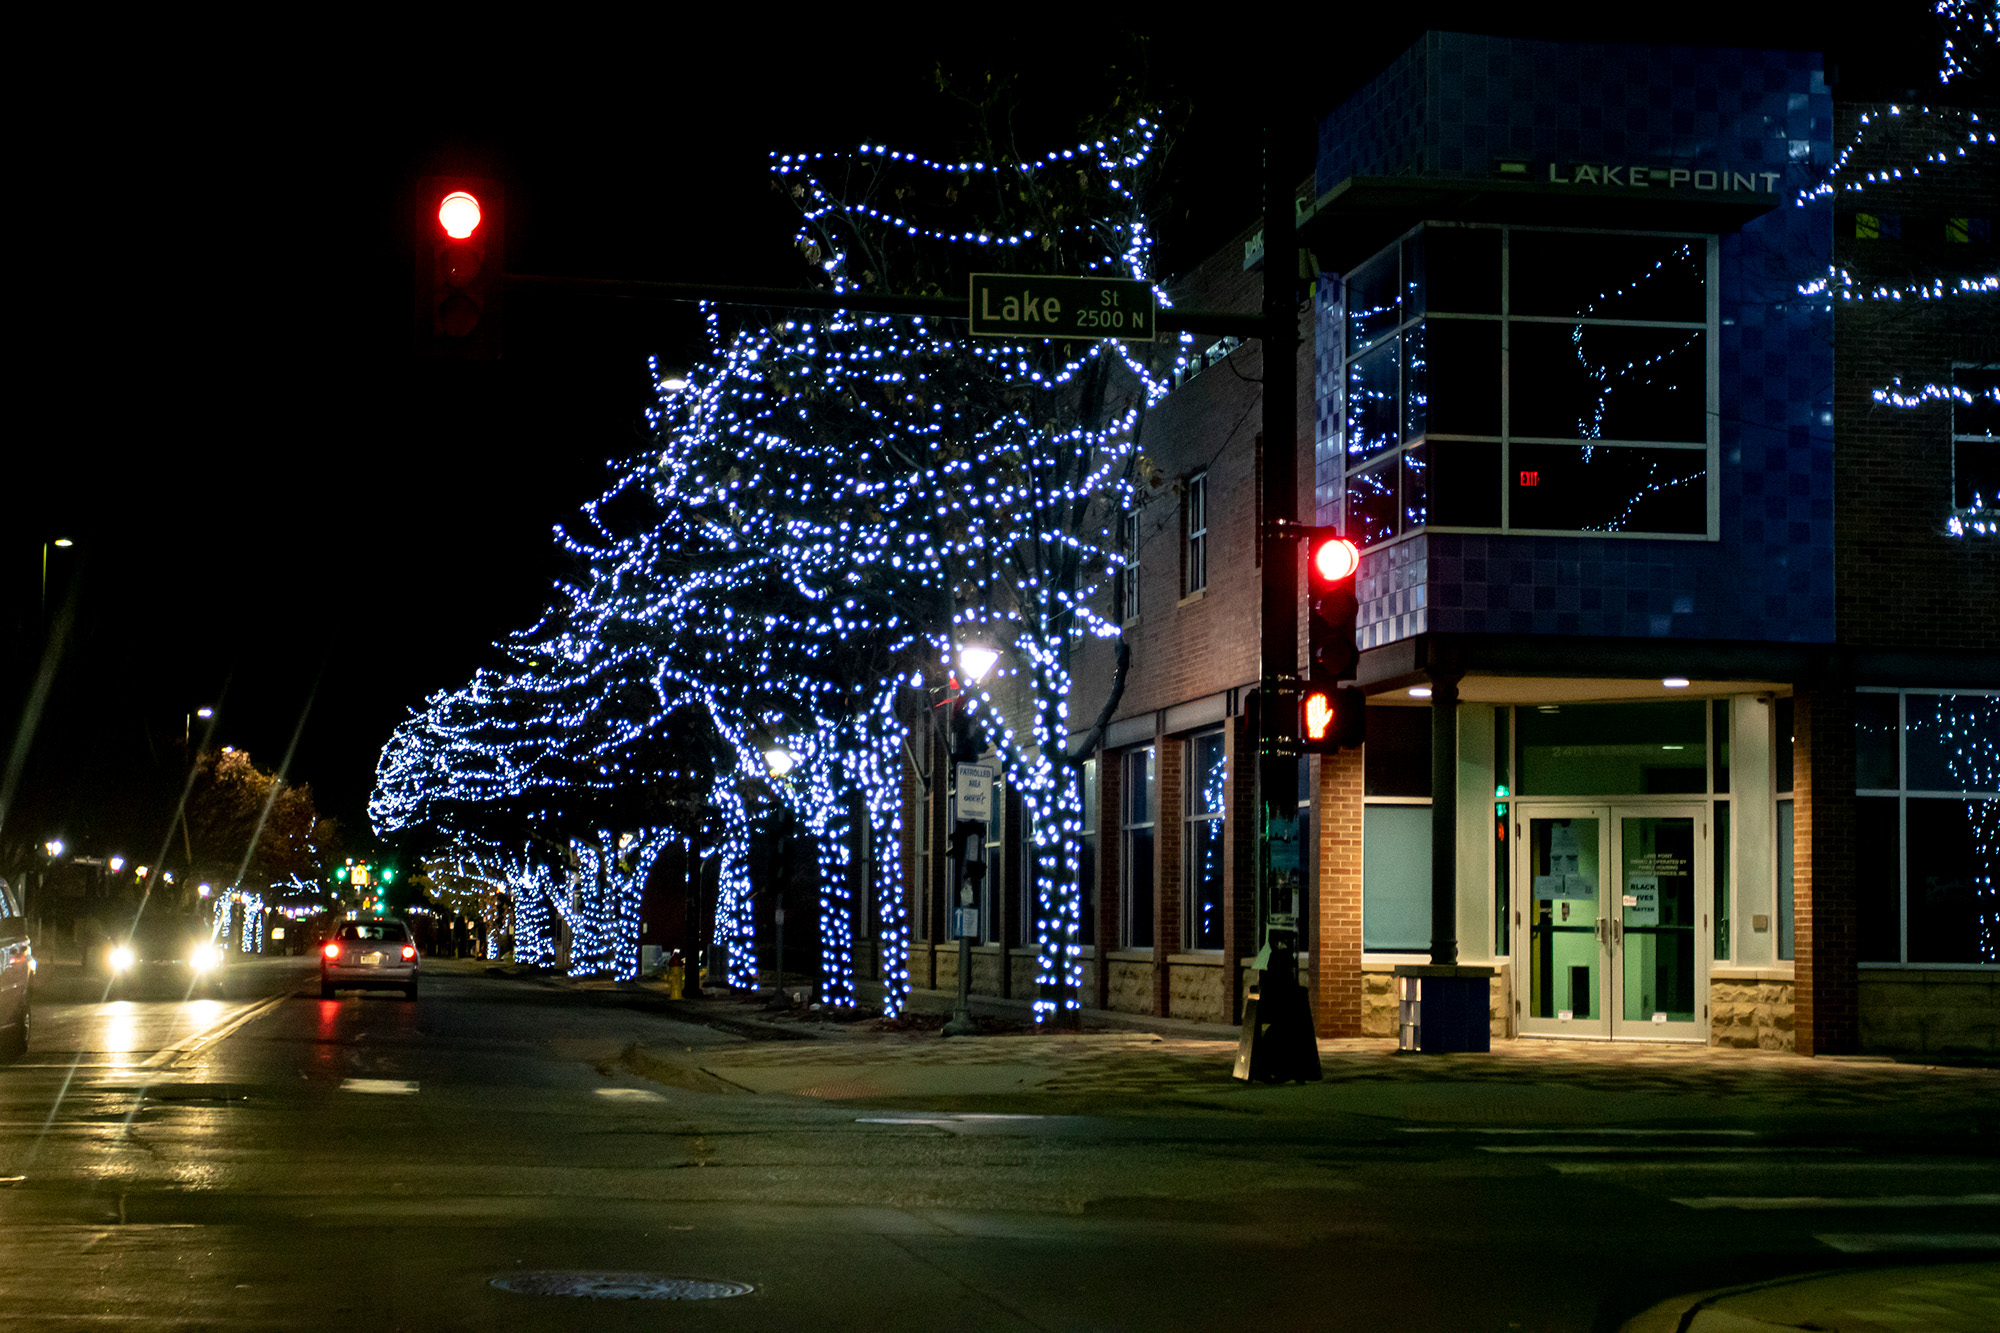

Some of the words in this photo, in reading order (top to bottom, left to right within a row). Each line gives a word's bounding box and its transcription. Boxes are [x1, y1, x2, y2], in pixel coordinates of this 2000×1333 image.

[1548, 162, 1650, 188] LAKE
[1668, 168, 1781, 194] POINT
[982, 287, 1061, 324] Lake
[1100, 289, 1120, 307] St
[1076, 309, 1124, 328] 2500
[1132, 311, 1144, 329] N
[1520, 470, 1539, 487] EXIT
[959, 767, 991, 778] PATROLLED
